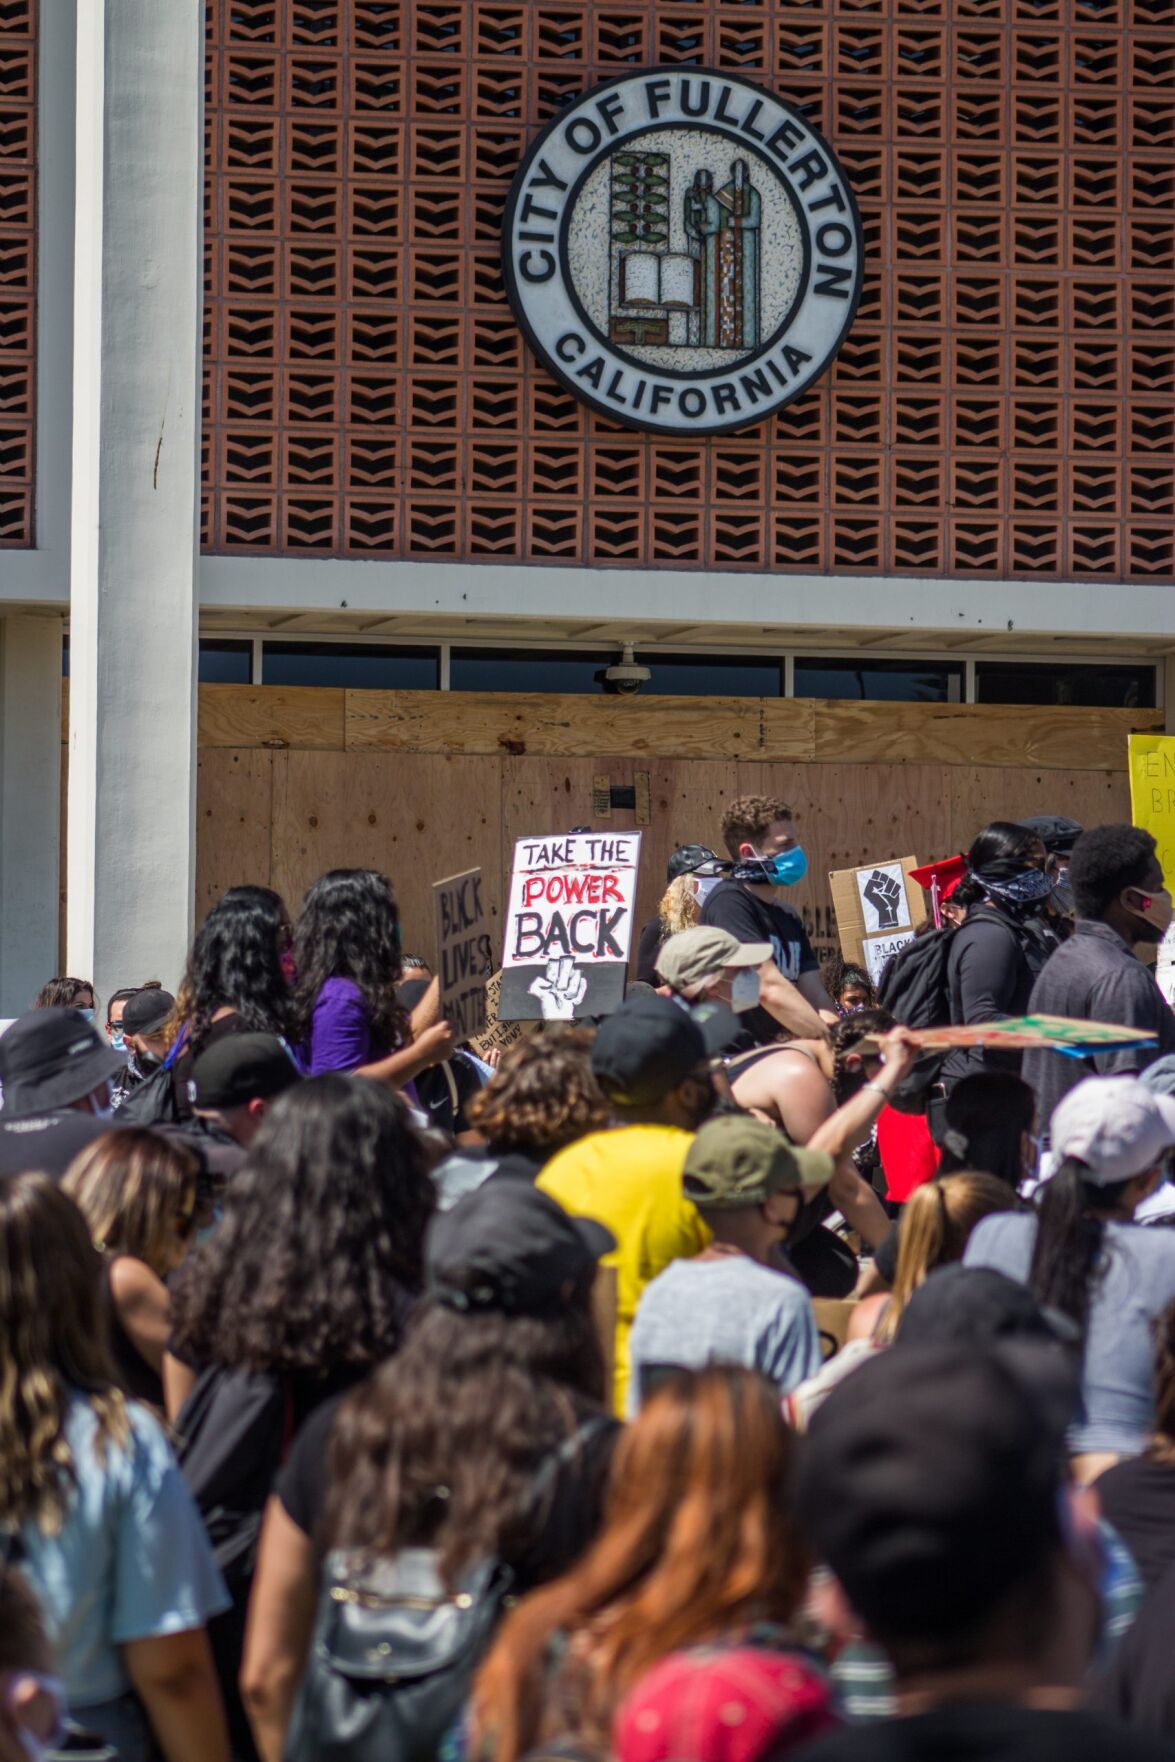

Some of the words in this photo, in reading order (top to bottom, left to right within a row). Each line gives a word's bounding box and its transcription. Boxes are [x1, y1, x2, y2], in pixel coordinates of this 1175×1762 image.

[518, 159, 570, 284] CITY
[564, 93, 625, 155] OF
[645, 79, 854, 300] FULLERTON
[555, 332, 813, 419] CALIFORNIA
[523, 838, 576, 865] TAKE
[585, 839, 632, 862] THE
[522, 874, 625, 907] POWER
[512, 907, 628, 958] BACK
[442, 934, 491, 991] LIVES
[443, 986, 487, 1035] MATTE
